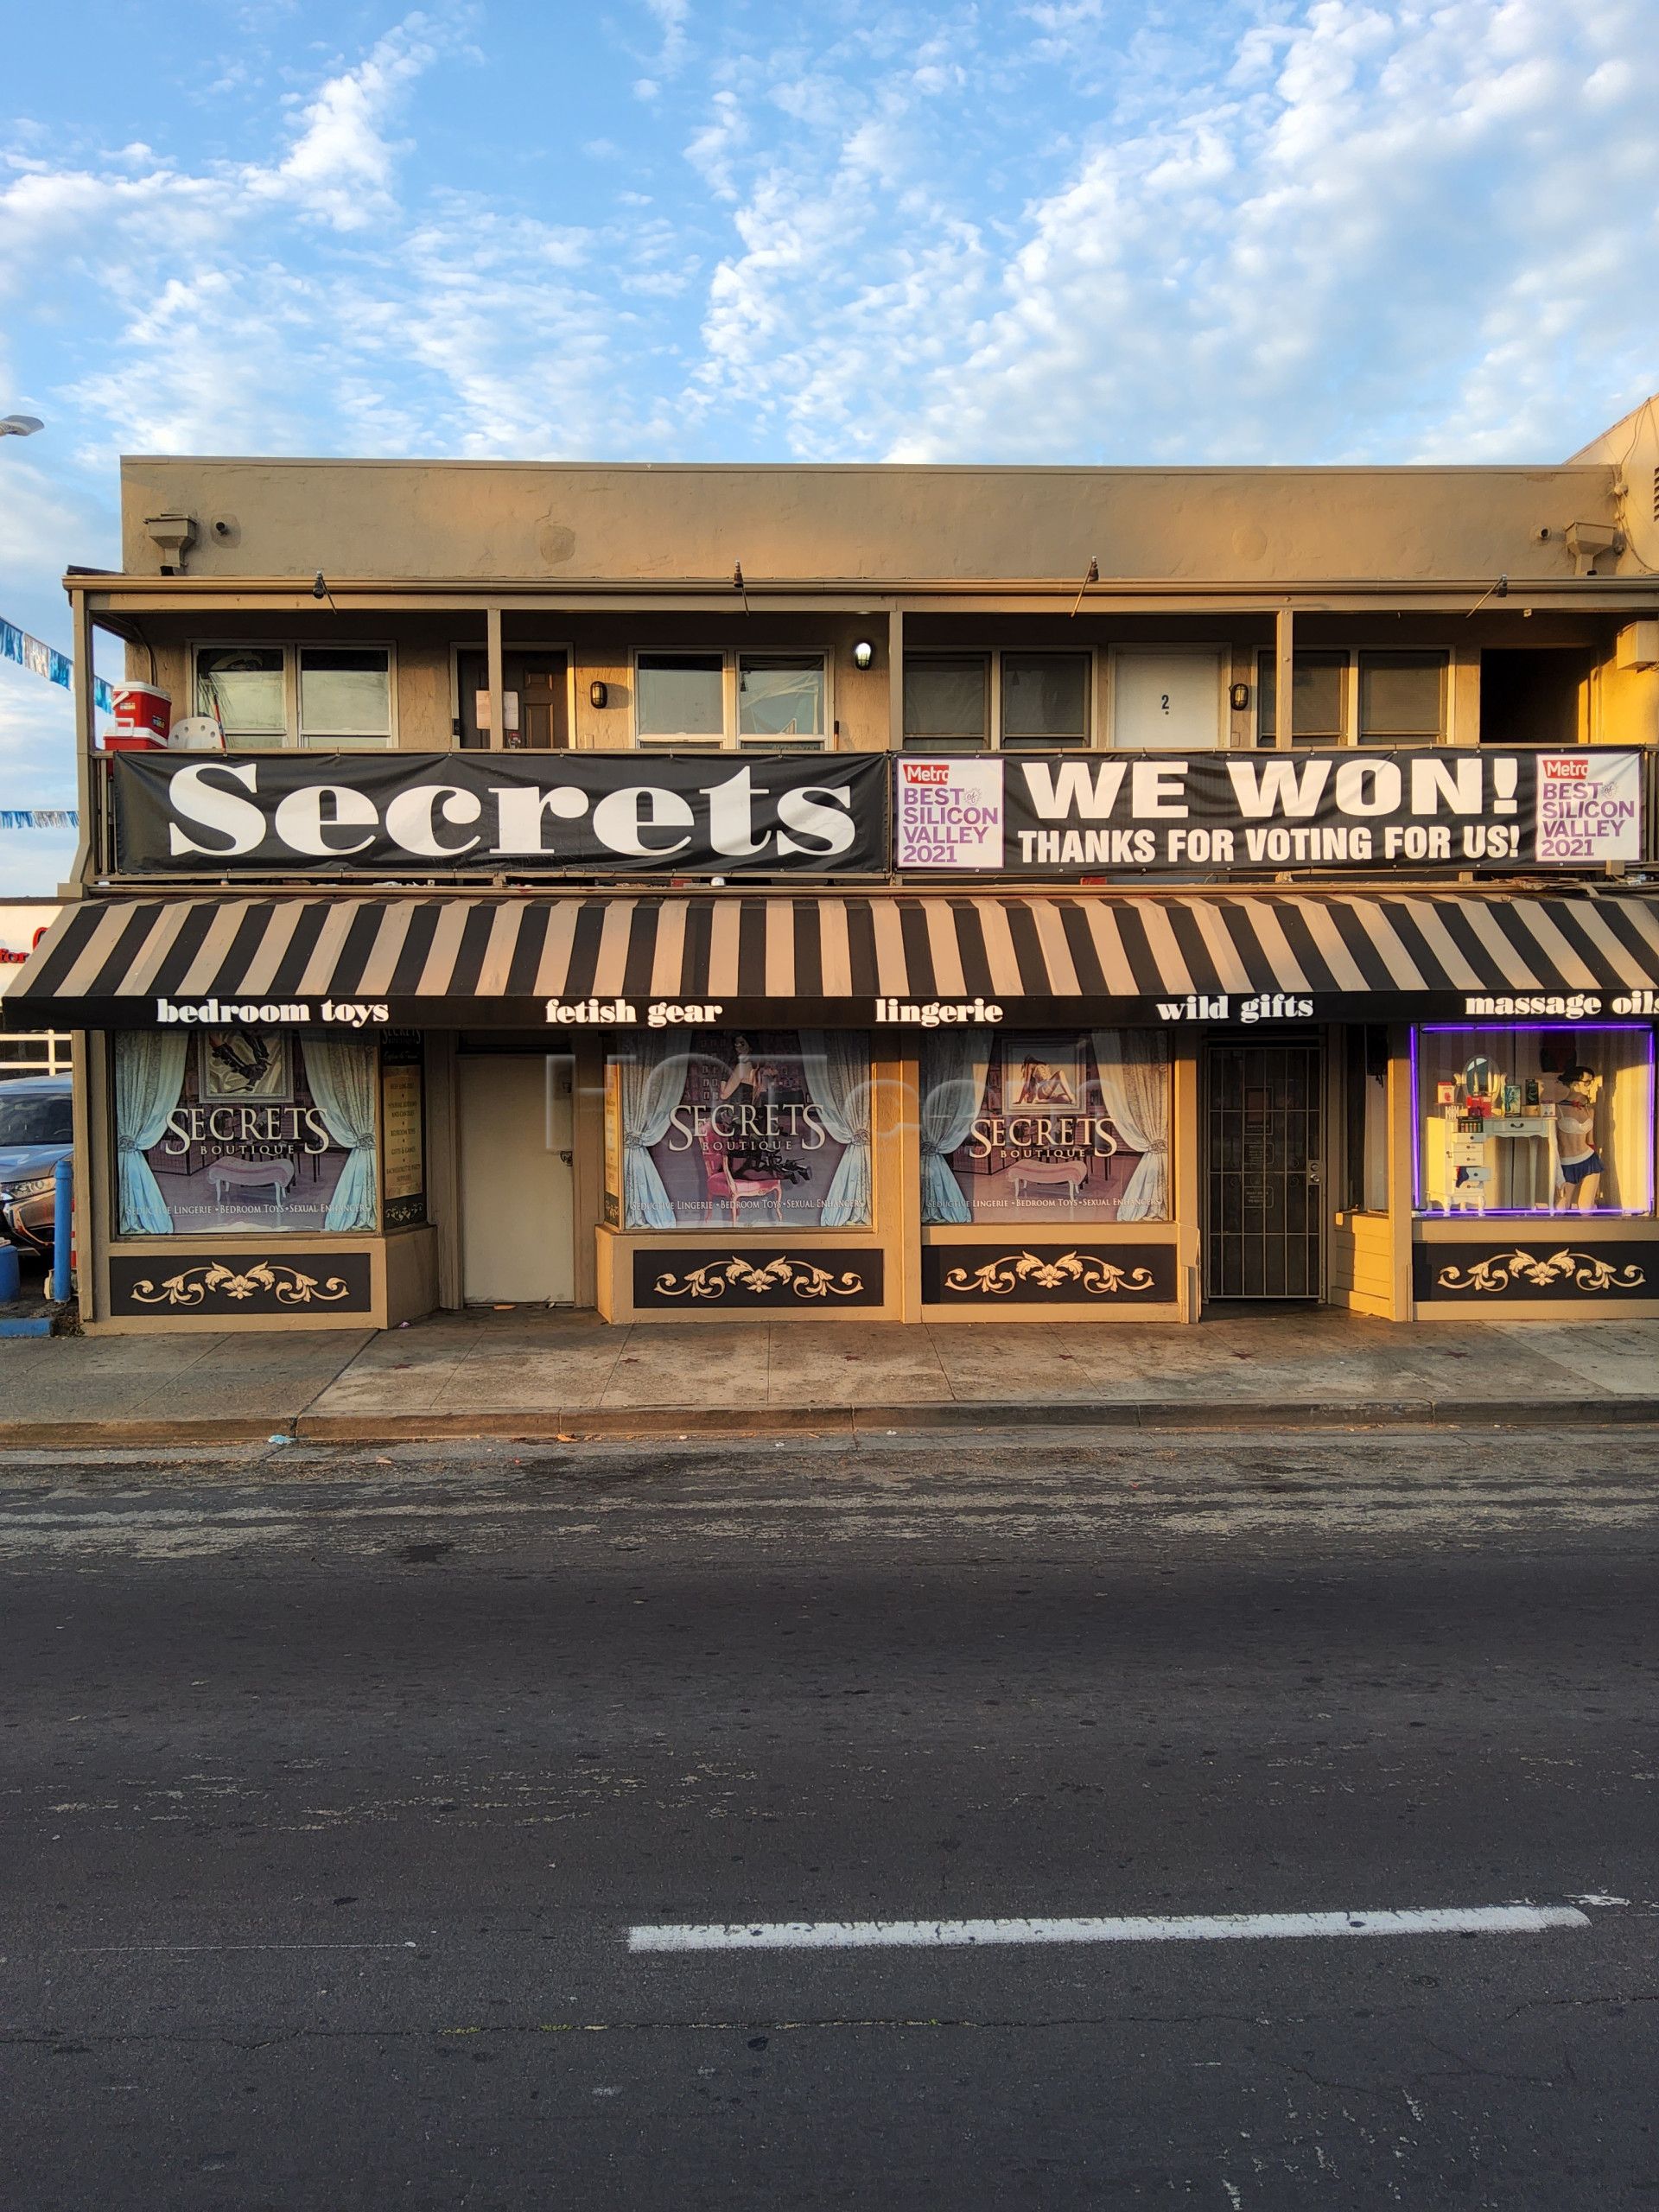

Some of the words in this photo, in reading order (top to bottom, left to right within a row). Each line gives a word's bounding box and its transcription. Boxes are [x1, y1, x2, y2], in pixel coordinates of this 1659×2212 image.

[1161, 694, 1170, 709] 2
[907, 766, 950, 782] Metro
[1547, 761, 1588, 777] Metro
[904, 788, 965, 805] BEST
[1021, 761, 1188, 818] WE
[1226, 759, 1517, 817] WON!
[1543, 782, 1603, 800] BEST
[168, 762, 855, 856] Secrets
[903, 807, 998, 824] SILICON
[1542, 801, 1635, 819] SILICON
[903, 826, 989, 843] VALLEY
[1542, 820, 1625, 838] VALLEY
[1018, 830, 1155, 862] THANKS
[1168, 830, 1234, 862] FOR
[1245, 827, 1371, 861] VOTING
[1385, 826, 1450, 859] FOR
[1464, 825, 1519, 858] US!
[1541, 839, 1594, 856] 2021
[903, 845, 957, 862] 2021
[156, 999, 311, 1023] bedroom
[321, 1000, 390, 1028] toys
[545, 999, 637, 1023] fetish
[647, 1001, 723, 1028] gear
[874, 999, 1004, 1028] lingerie
[1155, 995, 1230, 1020] wild
[1239, 994, 1315, 1024] gifts
[1465, 994, 1603, 1019] massage
[165, 1107, 329, 1155] SECRETS
[669, 1103, 826, 1151] SECRETS
[702, 1141, 792, 1152] BOUTIQUE
[969, 1118, 1118, 1159] SECRETS
[200, 1145, 295, 1155] BOUTIQUE
[1001, 1148, 1086, 1159] BOUTIQUE
